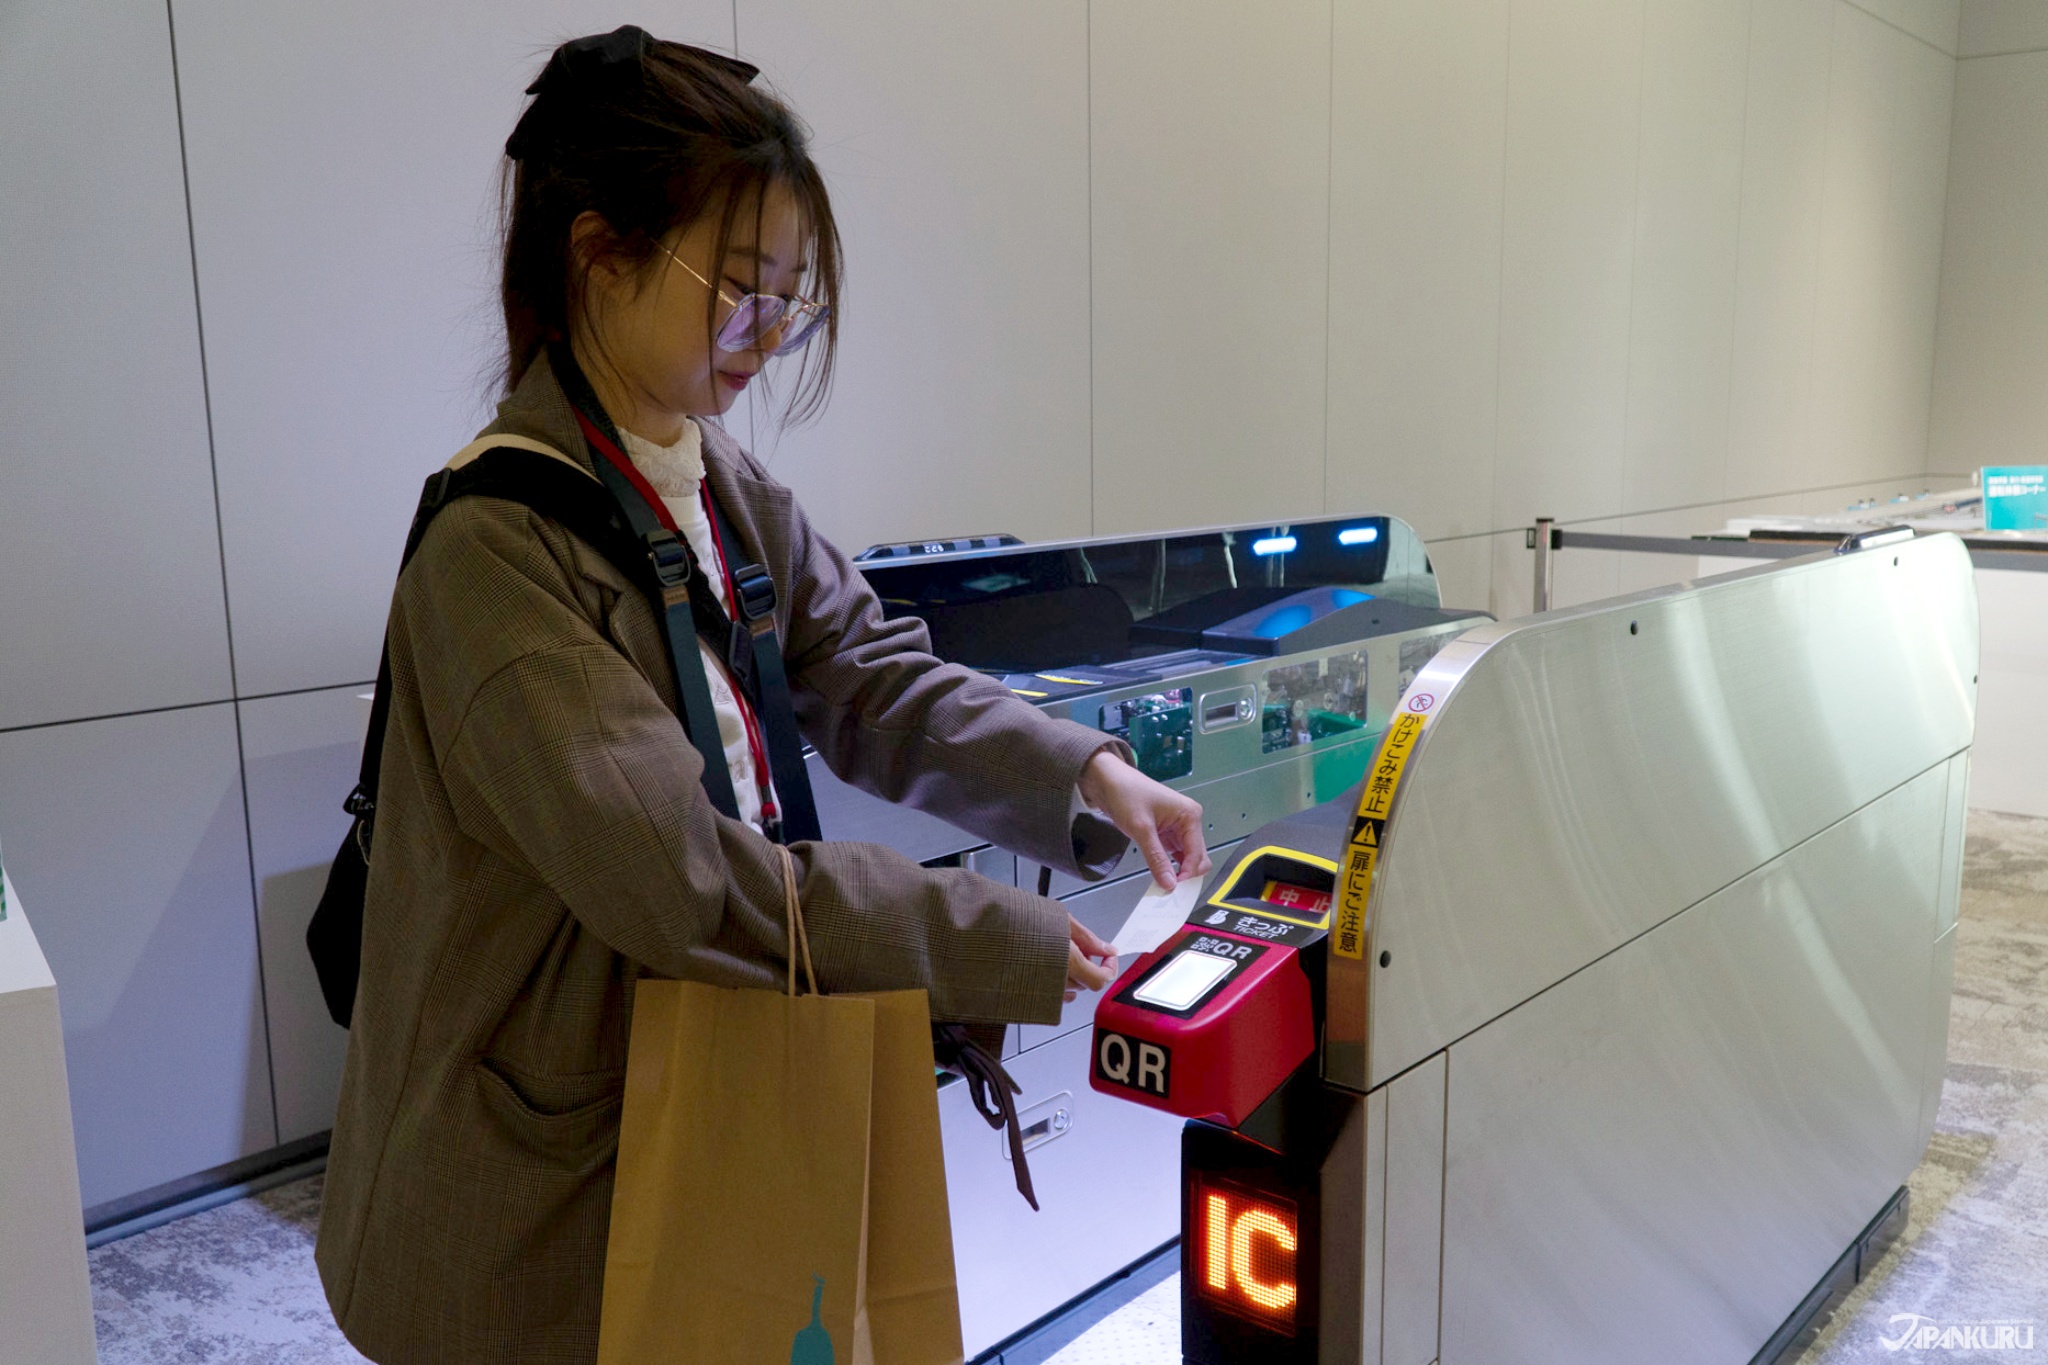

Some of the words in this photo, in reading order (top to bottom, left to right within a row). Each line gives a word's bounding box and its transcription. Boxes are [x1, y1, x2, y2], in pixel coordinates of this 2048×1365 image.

[1365, 713, 1420, 814] かけこみ禁止
[1280, 888, 1330, 913] 中止
[1339, 851, 1371, 953] 扉にご注意
[1213, 942, 1252, 959] QR
[1234, 925, 1279, 938] TICKET
[1100, 1033, 1165, 1093] QR
[1208, 1195, 1295, 1309] IC
